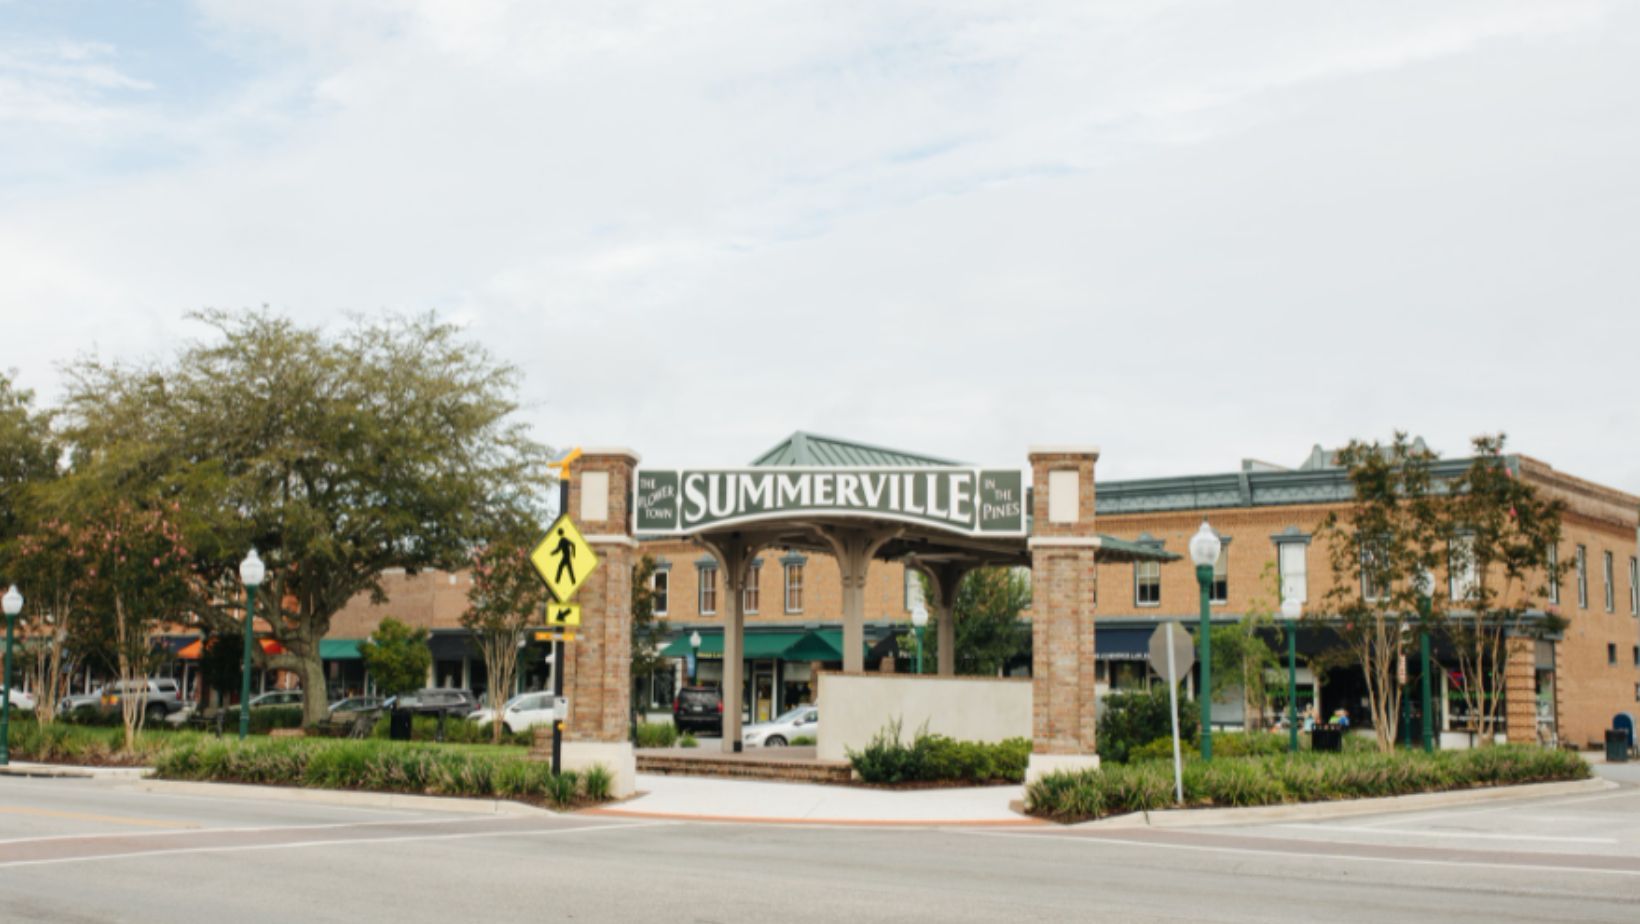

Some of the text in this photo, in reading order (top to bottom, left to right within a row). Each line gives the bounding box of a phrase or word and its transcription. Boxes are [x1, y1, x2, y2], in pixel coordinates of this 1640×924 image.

[640, 478, 655, 489] THE
[984, 479, 995, 489] IN
[638, 486, 674, 507] FLOWER
[684, 473, 971, 523] SUMMERVILLE
[995, 490, 1011, 501] THE
[645, 508, 672, 519] TOWN
[983, 501, 1019, 520] PINES
